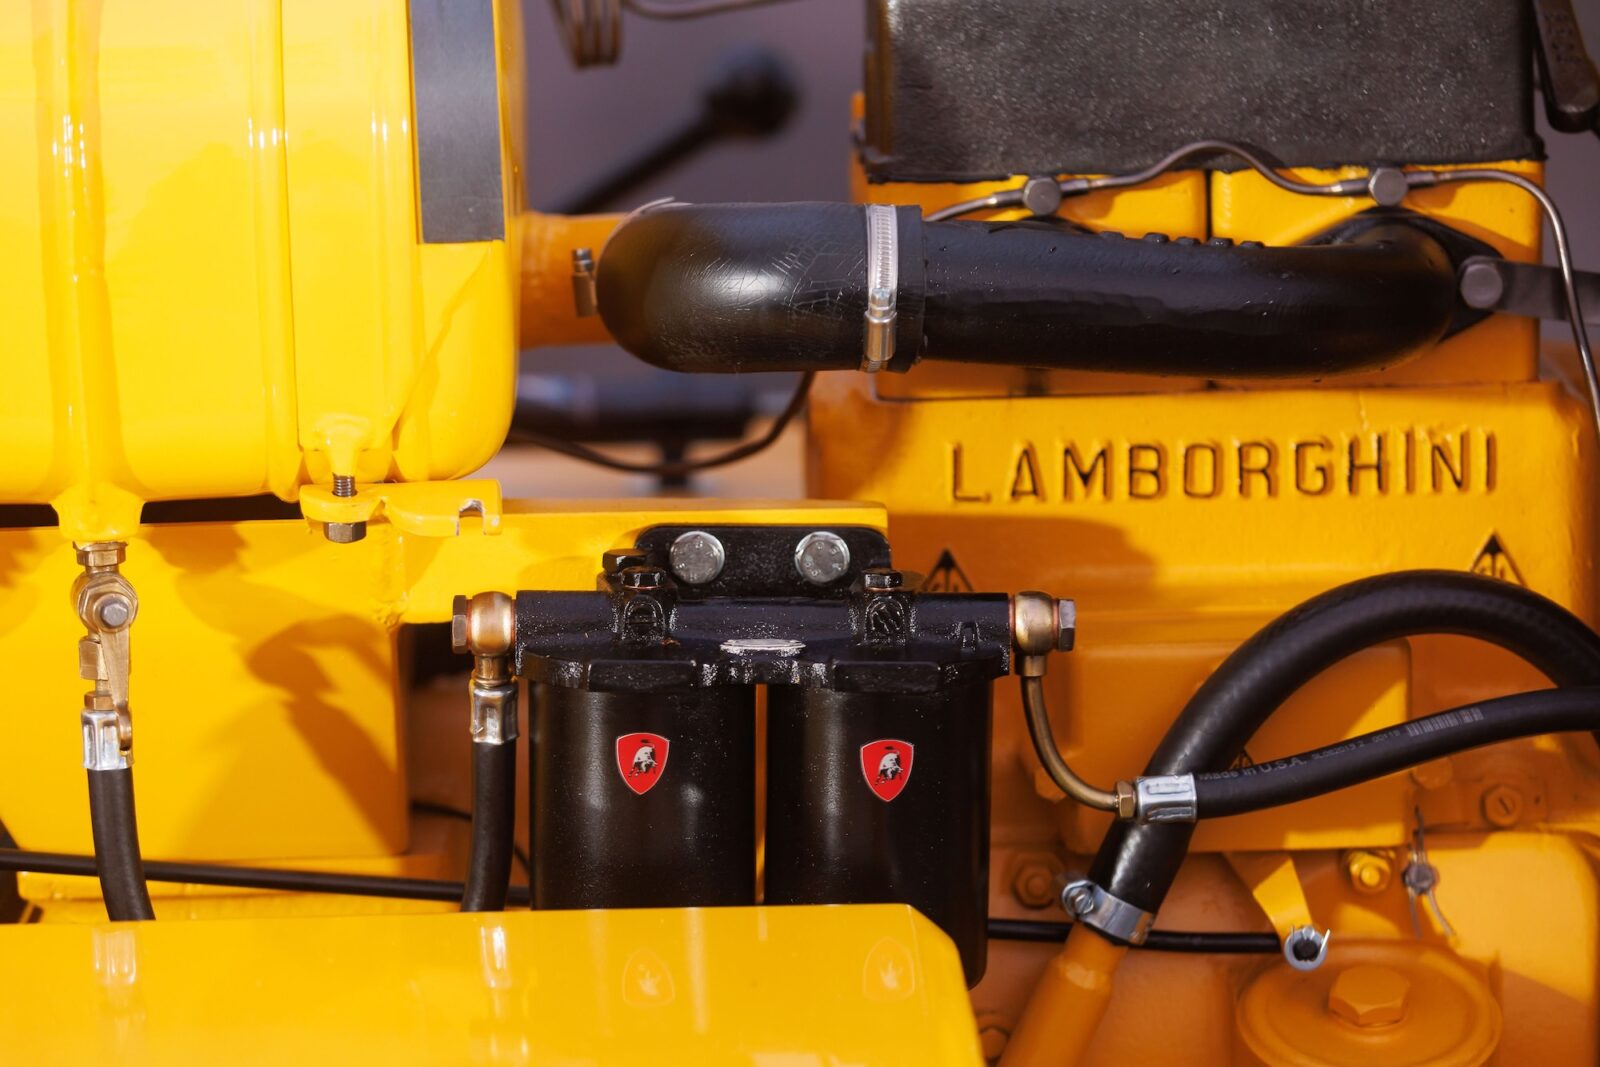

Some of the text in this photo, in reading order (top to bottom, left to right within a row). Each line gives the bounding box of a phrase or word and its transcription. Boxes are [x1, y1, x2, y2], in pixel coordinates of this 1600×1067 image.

[949, 430, 1499, 502] LAMBORGHINI
[1198, 770, 1239, 781] Made
[1242, 767, 1258, 776] in
